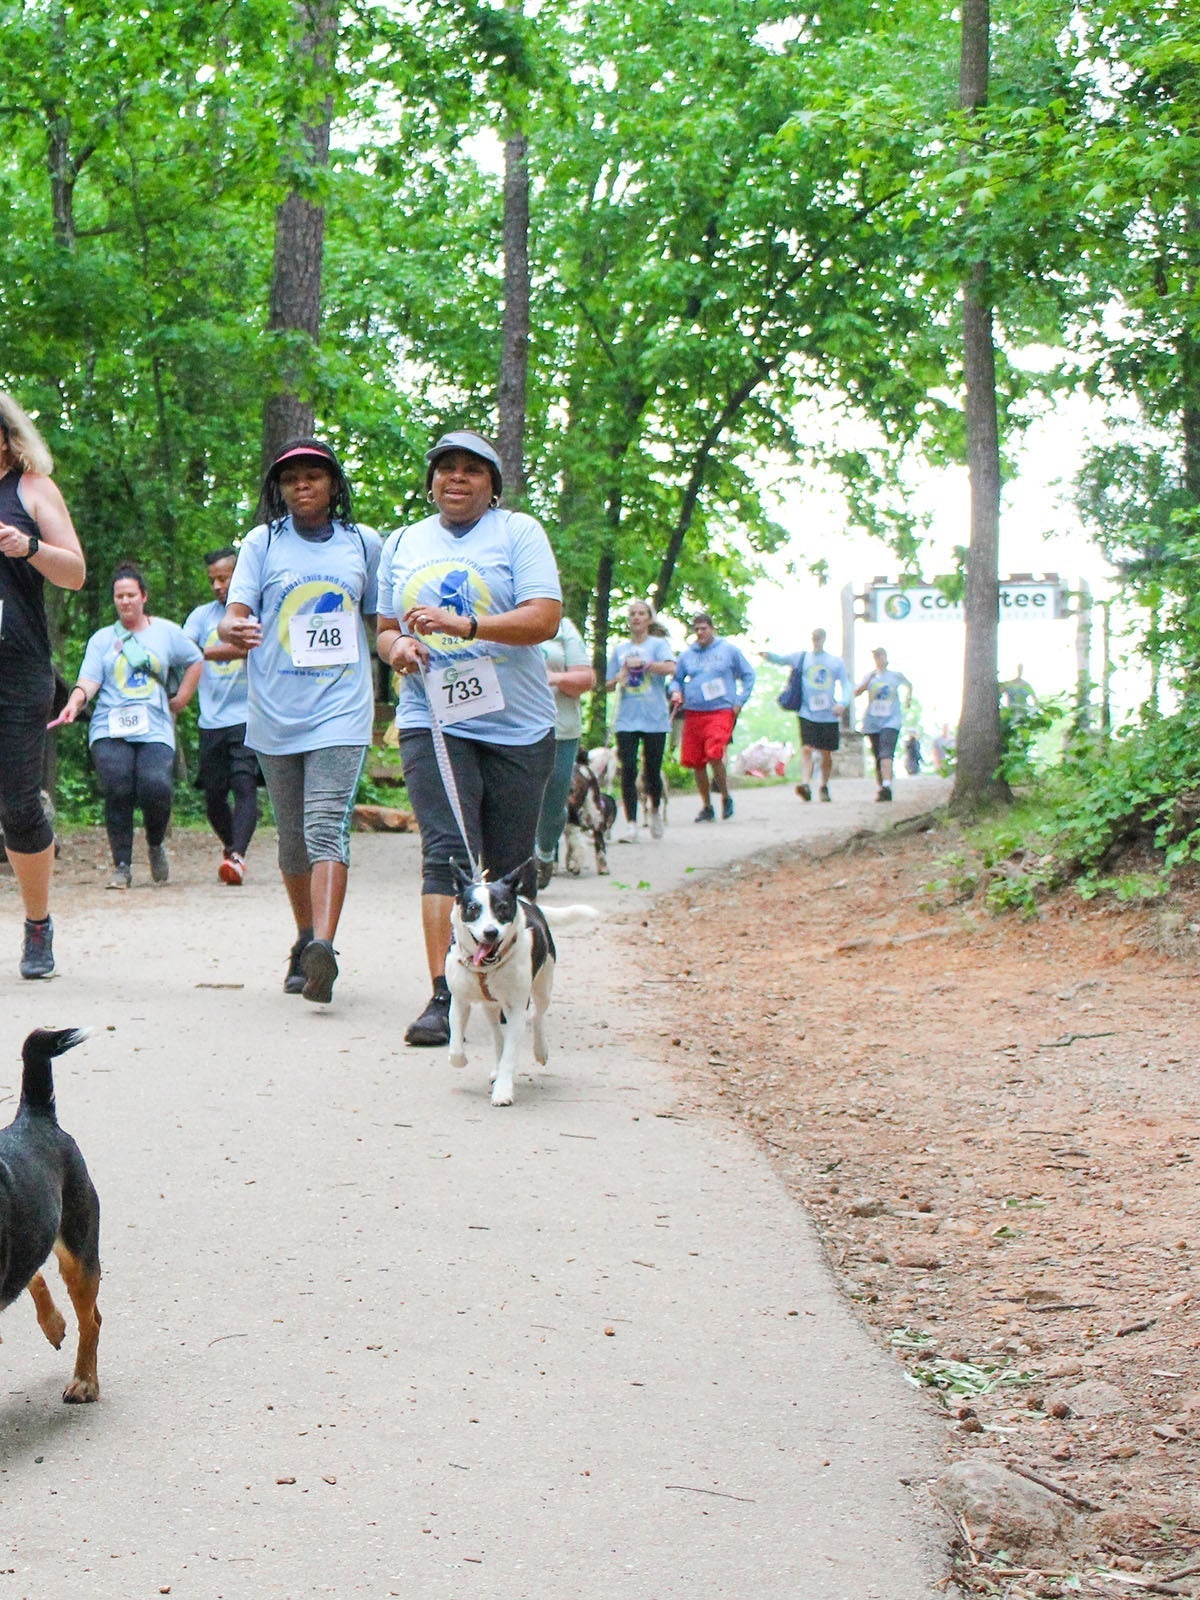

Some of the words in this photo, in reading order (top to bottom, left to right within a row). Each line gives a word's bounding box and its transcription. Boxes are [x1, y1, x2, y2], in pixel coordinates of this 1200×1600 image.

[306, 628, 342, 648] 748
[442, 677, 483, 704] 733
[118, 715, 139, 728] 358
